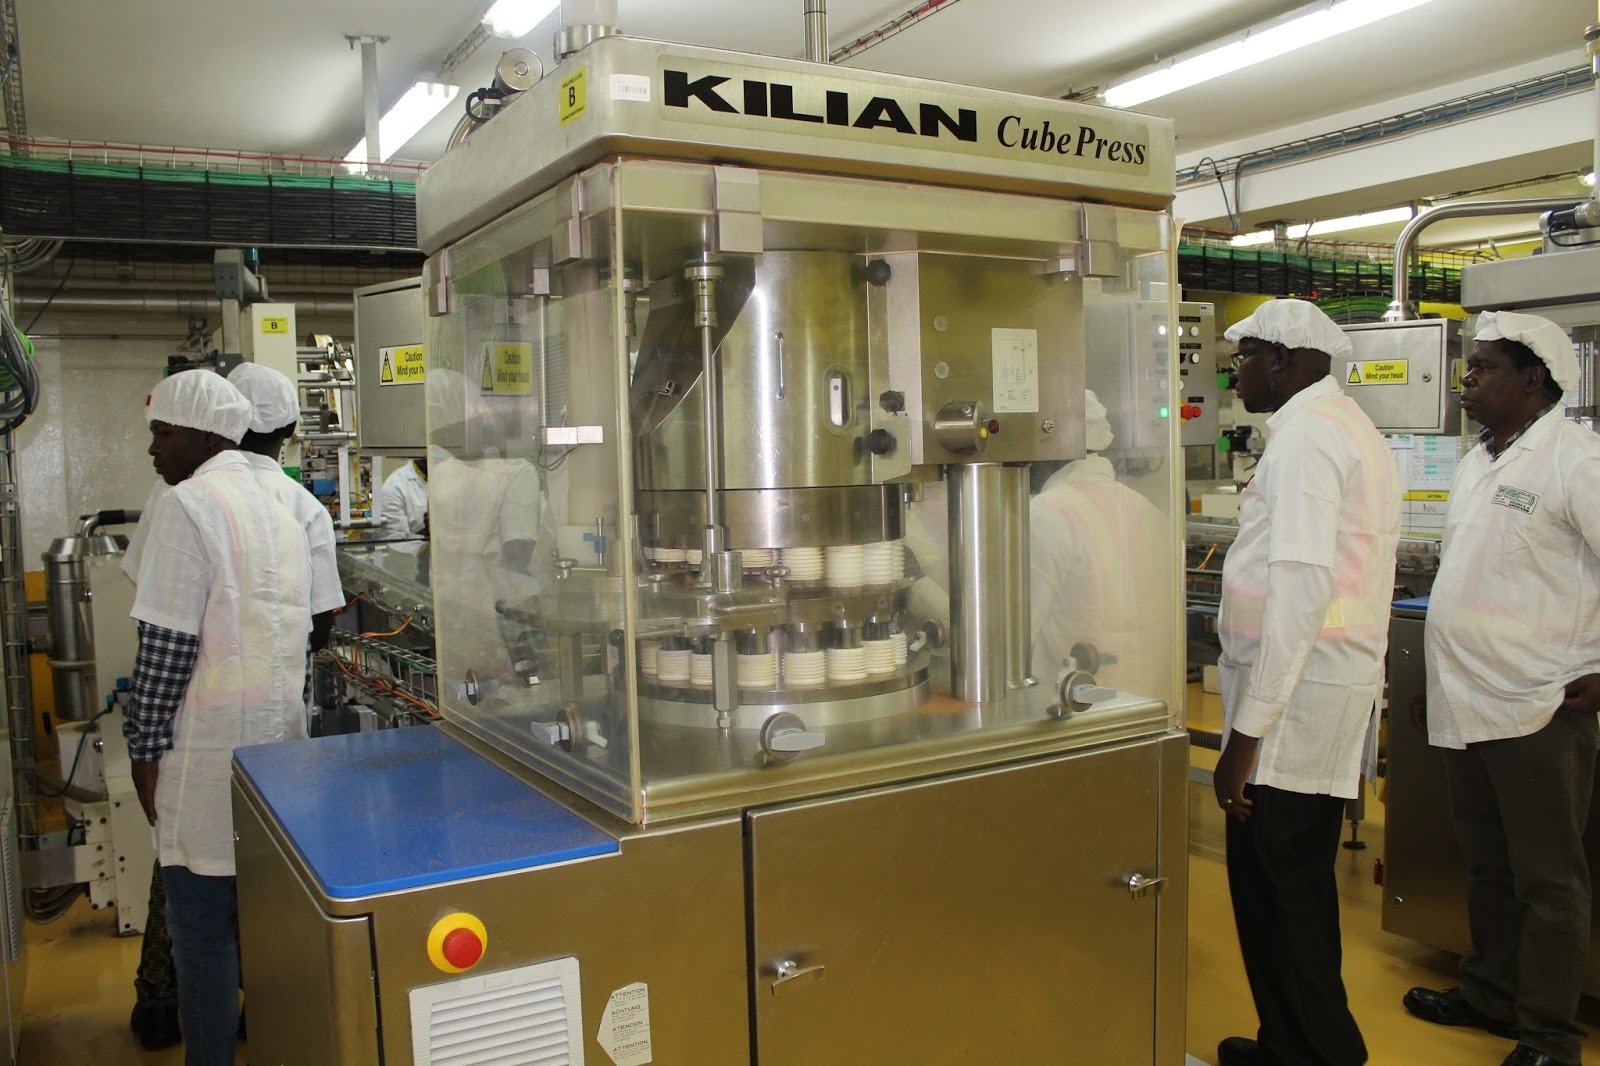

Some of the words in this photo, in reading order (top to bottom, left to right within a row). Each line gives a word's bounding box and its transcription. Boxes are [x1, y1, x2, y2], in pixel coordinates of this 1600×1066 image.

[568, 86, 576, 108] B
[663, 69, 977, 143] KILIAN
[271, 321, 278, 330] B
[405, 352, 422, 362] Caution
[396, 365, 408, 375] Mind
[408, 366, 419, 378] your
[610, 987, 646, 1000] ATTENTION
[611, 1004, 641, 1016] ACHTUNG
[613, 1040, 648, 1053] ATTENTION
